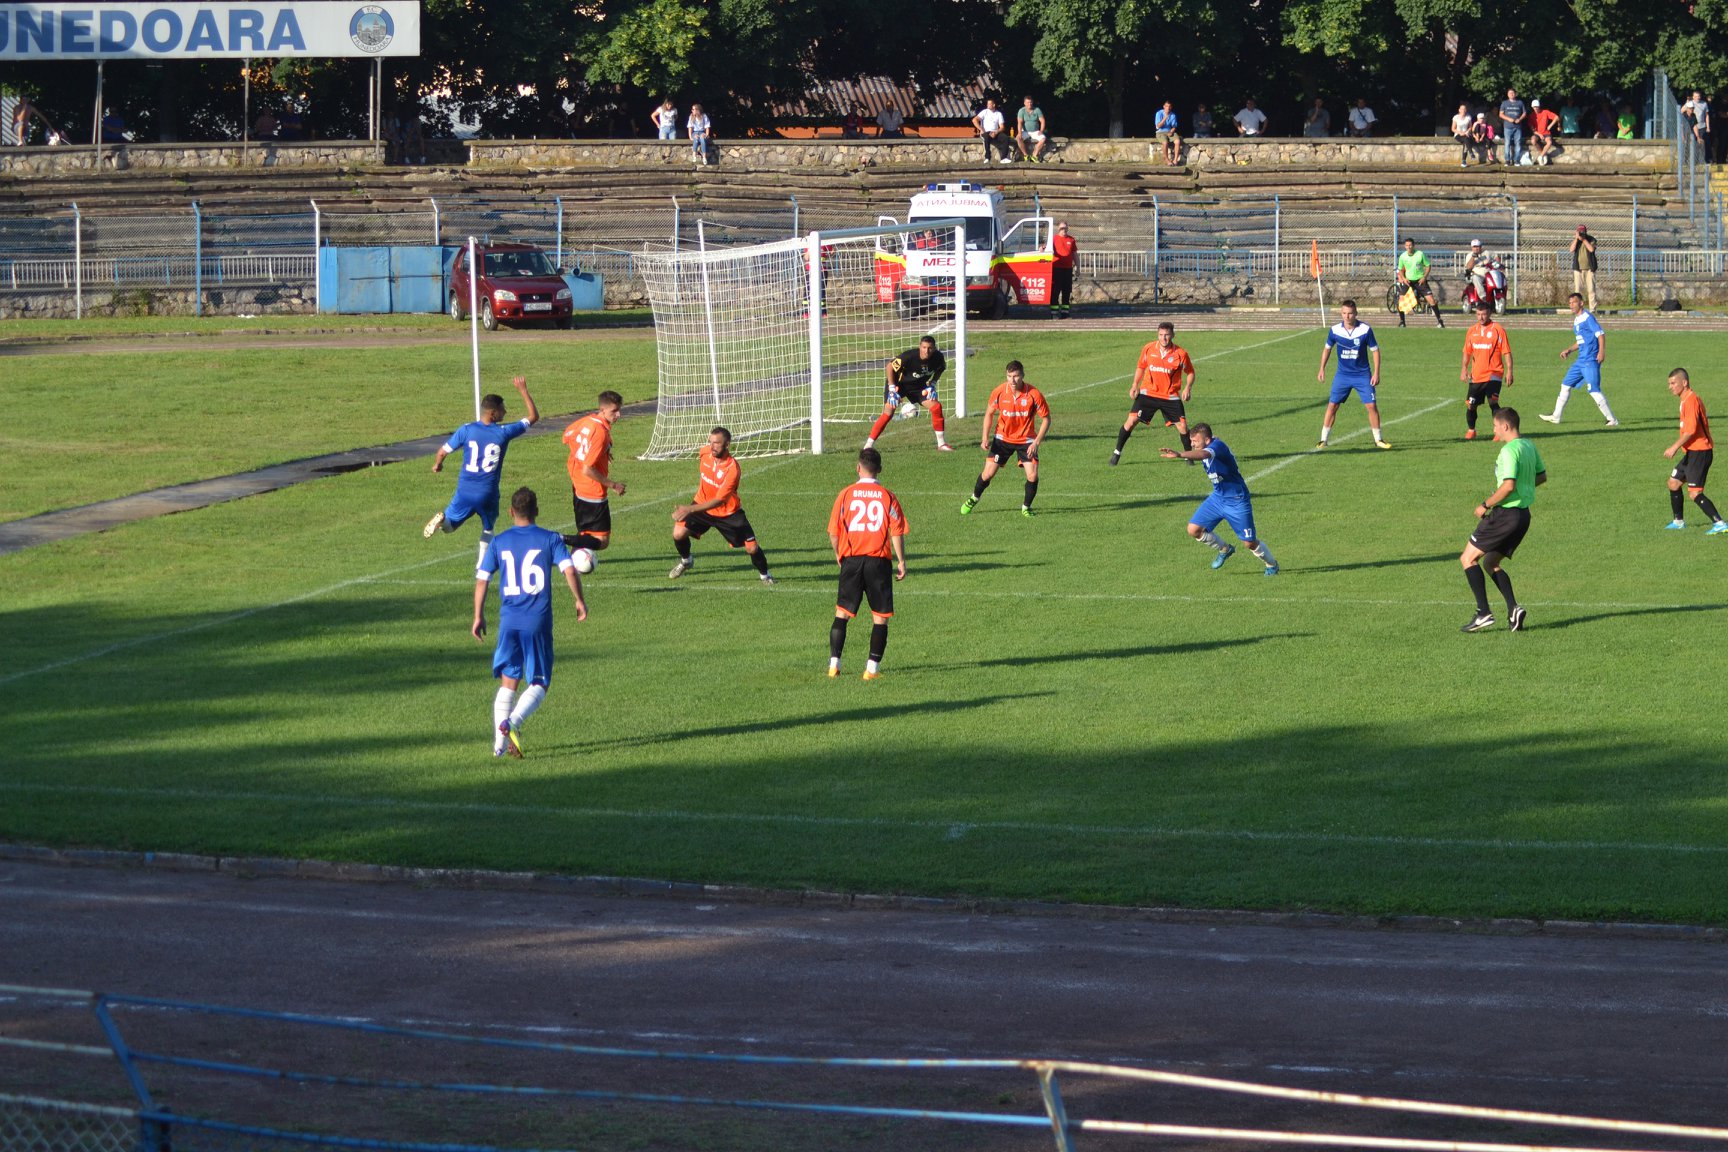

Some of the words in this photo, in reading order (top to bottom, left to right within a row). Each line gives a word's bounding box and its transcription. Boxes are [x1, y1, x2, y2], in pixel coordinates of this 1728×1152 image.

[0, 9, 307, 53] NEDOARA
[1027, 277, 1046, 288] 112
[466, 440, 500, 473] 18
[853, 489, 882, 499] BRUMAR
[848, 499, 884, 532] 29
[501, 549, 545, 596] 16
